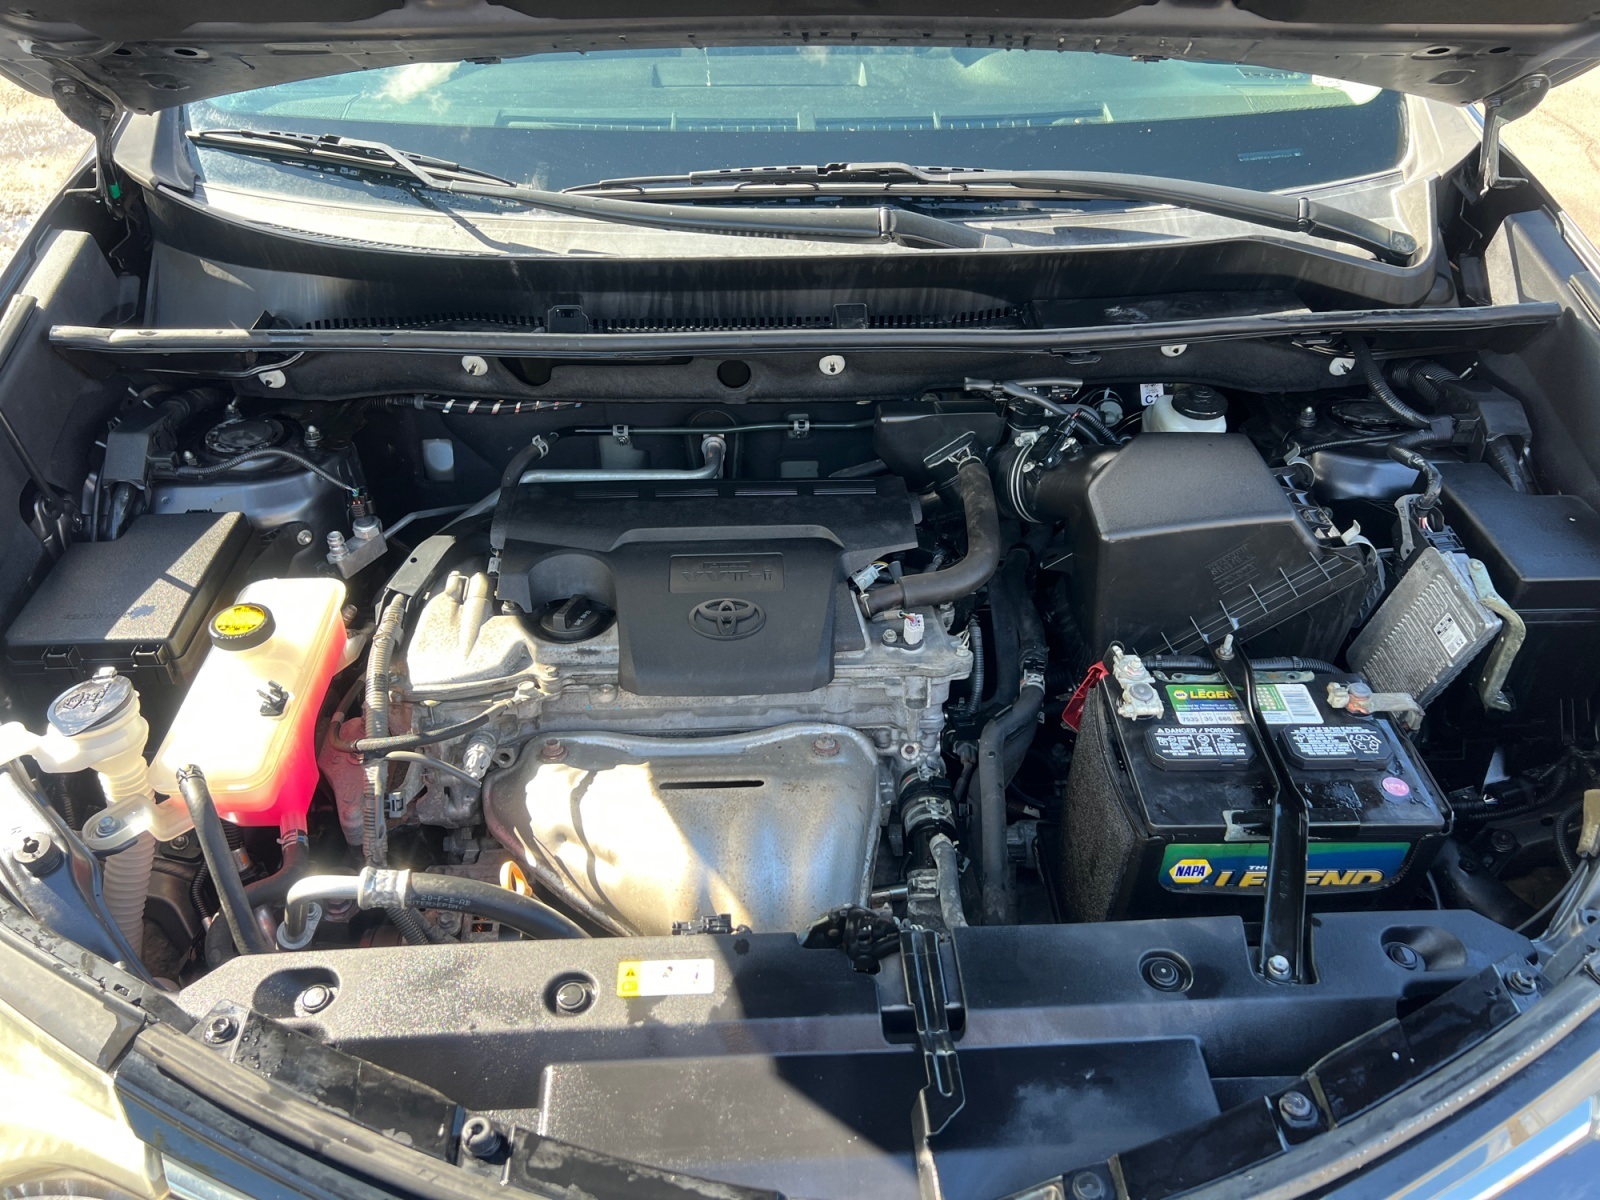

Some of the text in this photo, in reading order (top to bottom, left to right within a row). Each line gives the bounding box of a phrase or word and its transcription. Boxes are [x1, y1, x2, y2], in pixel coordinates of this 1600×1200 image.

[1189, 690, 1234, 699] LEGEN
[1175, 865, 1206, 877] NAPA
[1214, 868, 1384, 888] LEEND
